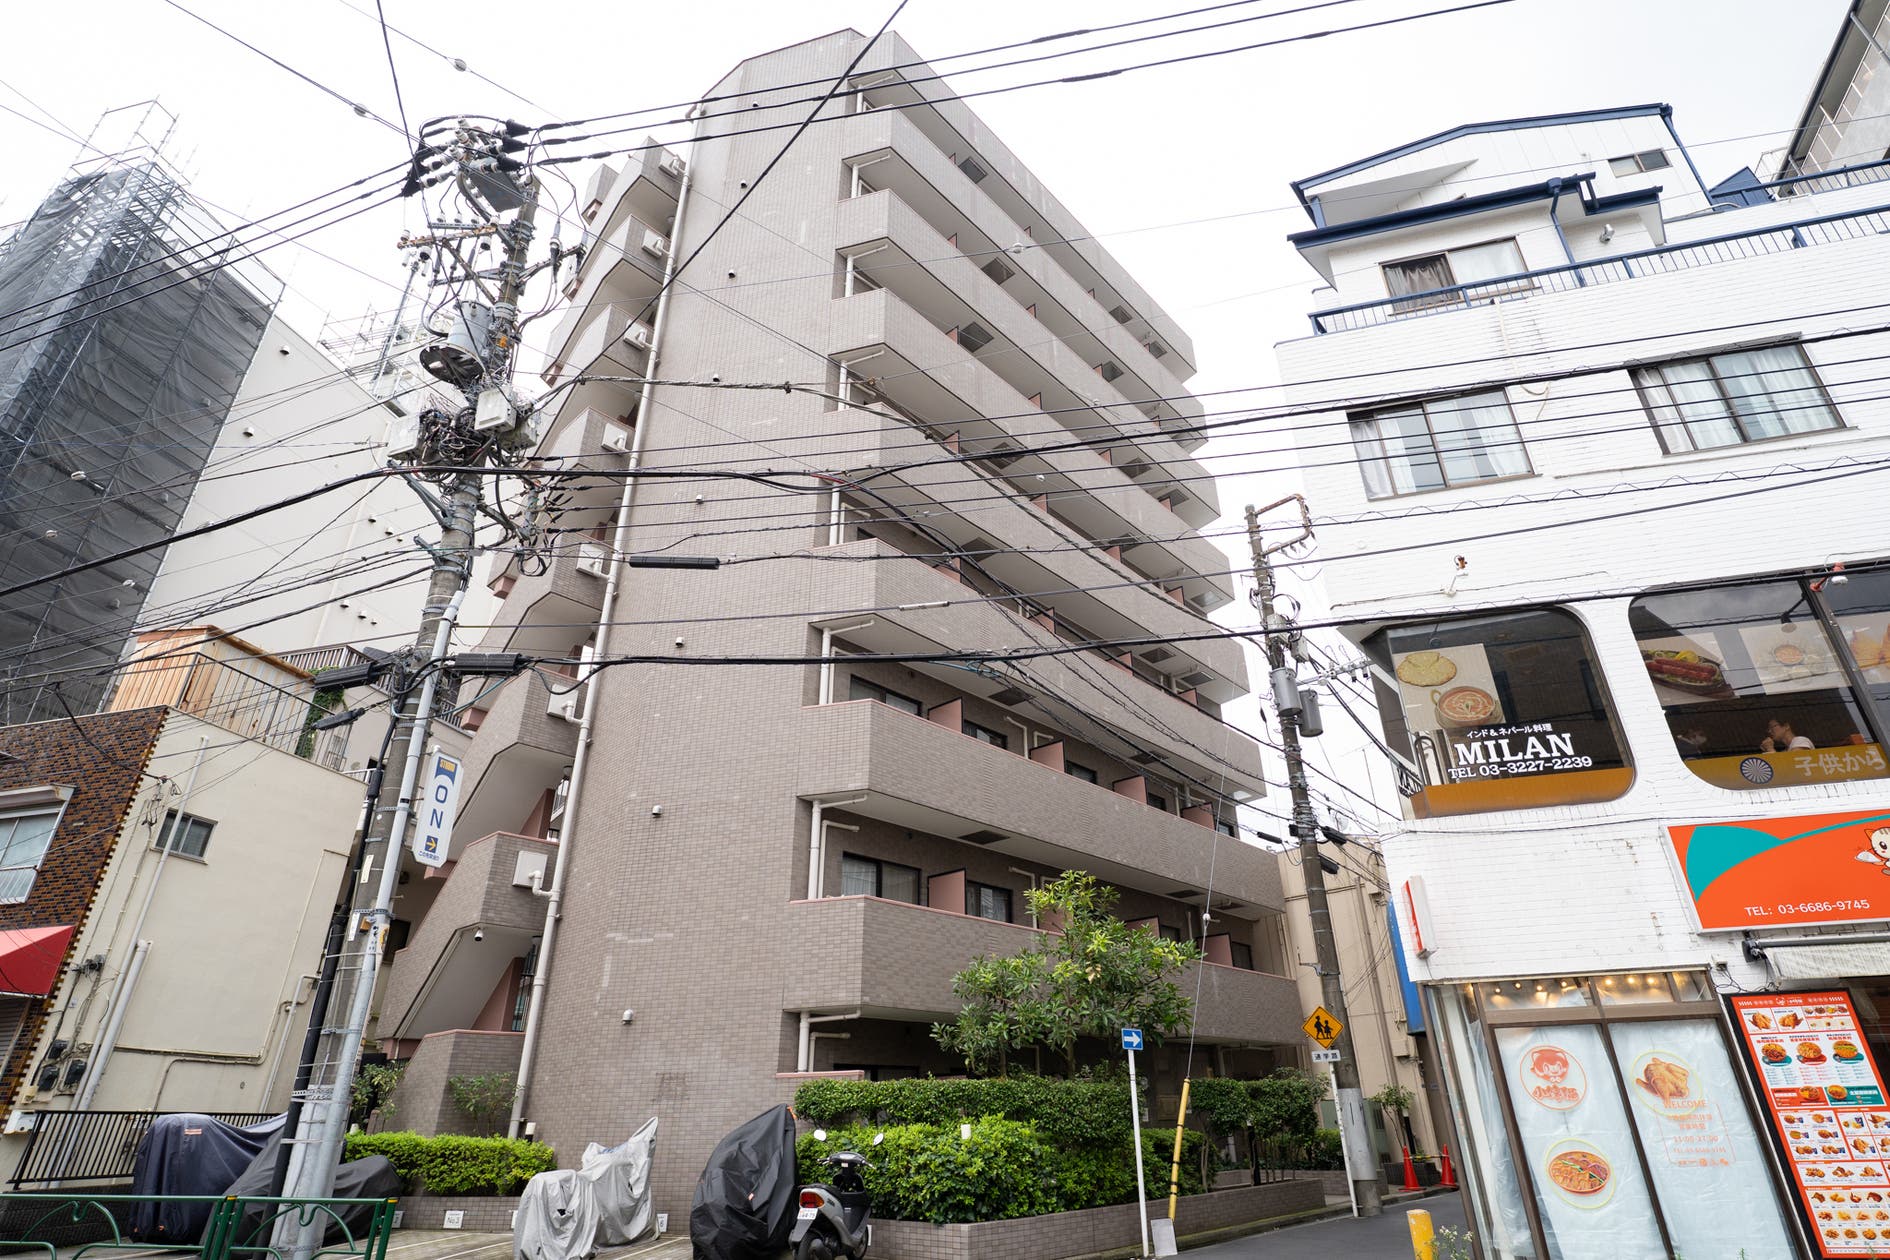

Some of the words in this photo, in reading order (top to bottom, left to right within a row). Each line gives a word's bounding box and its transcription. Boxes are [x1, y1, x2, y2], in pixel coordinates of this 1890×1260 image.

[1466, 723, 1553, 739] インド&ネパール料理
[1453, 733, 1575, 766] MILAN
[1448, 766, 1476, 779] TEL
[1479, 755, 1593, 776] 03-3227-2239
[1744, 905, 1773, 917] TEL:
[1777, 899, 1871, 915] 03-6686-9745
